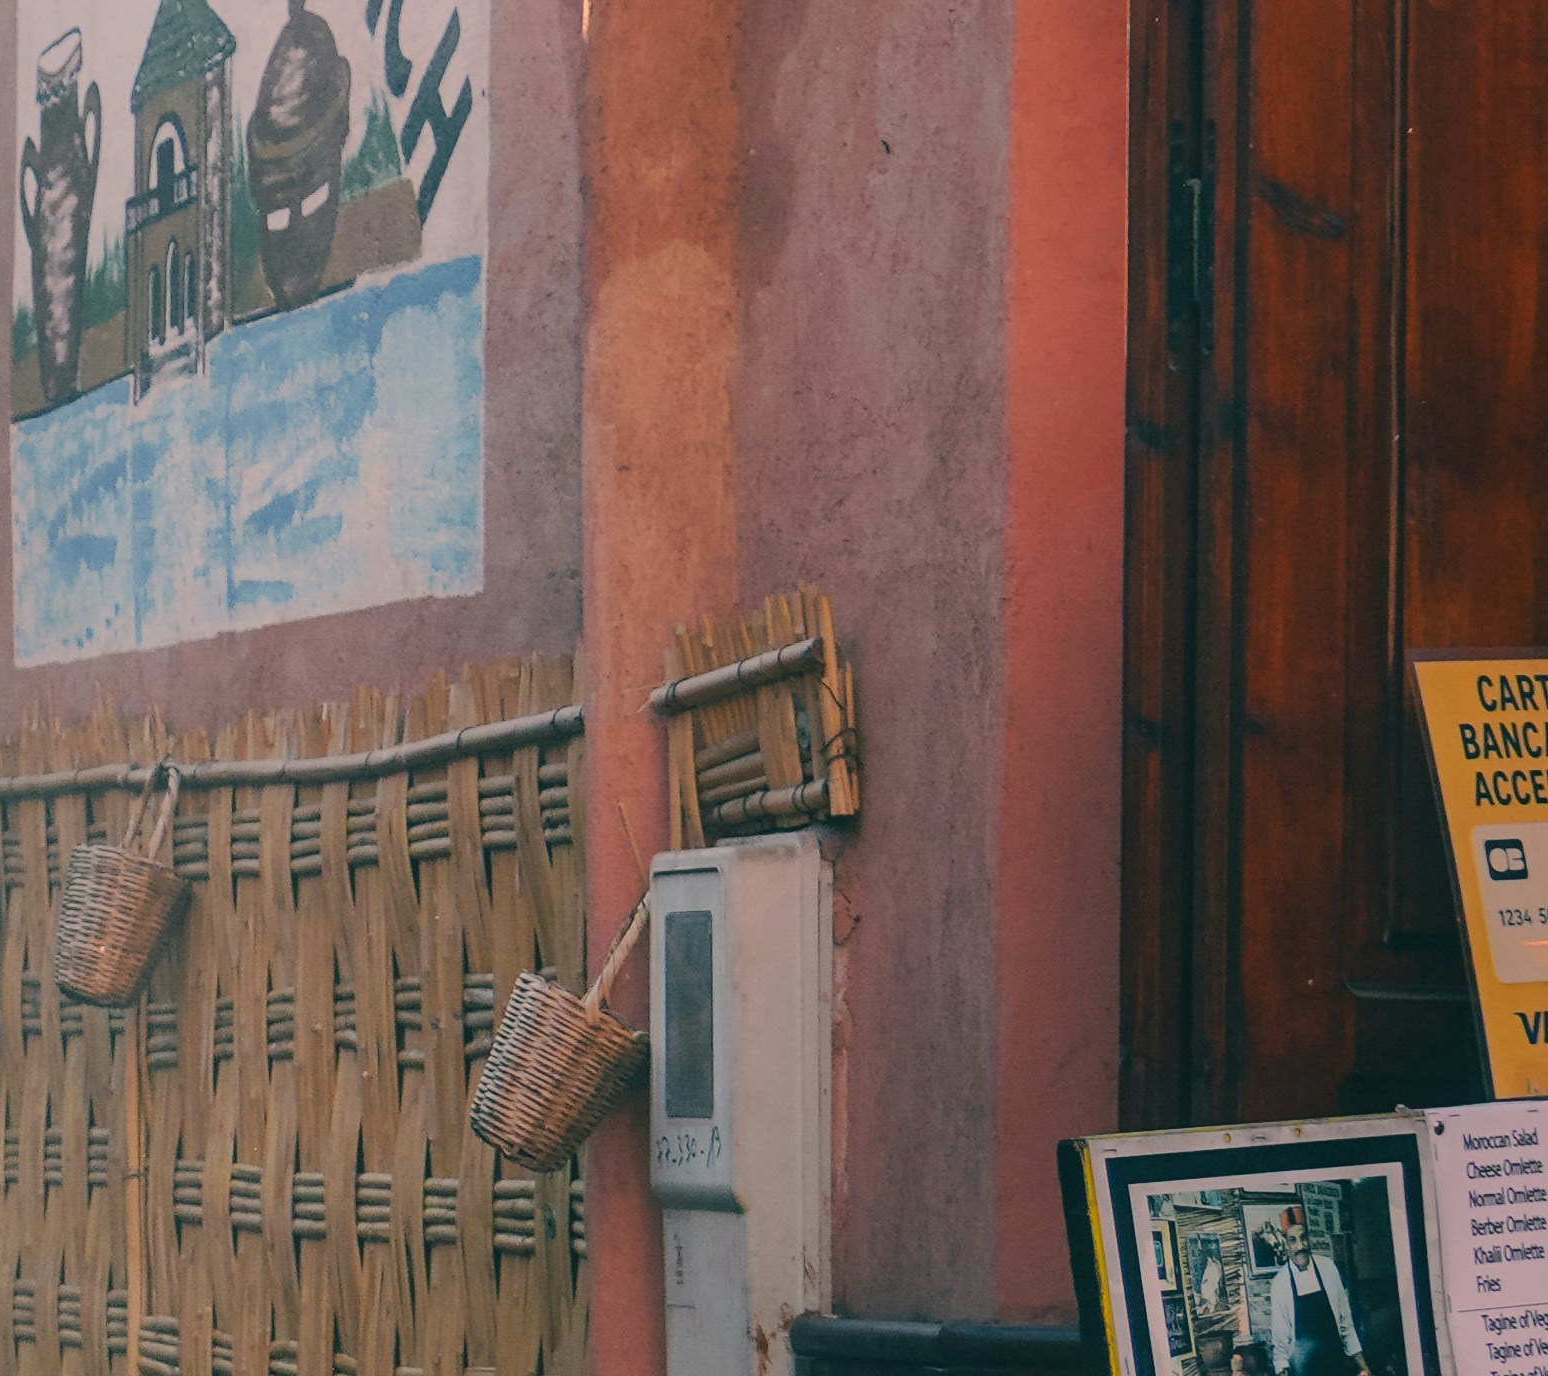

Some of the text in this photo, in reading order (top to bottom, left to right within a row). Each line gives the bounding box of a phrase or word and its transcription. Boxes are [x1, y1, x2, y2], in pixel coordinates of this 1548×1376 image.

[1498, 907, 1548, 926] 1234 5
[1462, 1127, 1539, 1152] Moroccan Salad
[1466, 1156, 1544, 1180] Cheese Omlette
[1468, 1187, 1506, 1208] Normal
[1470, 1217, 1505, 1236] Berber
[1475, 1275, 1502, 1293] Fries
[1481, 1313, 1517, 1336] Tagine
[1485, 1341, 1522, 1364] Tagine
